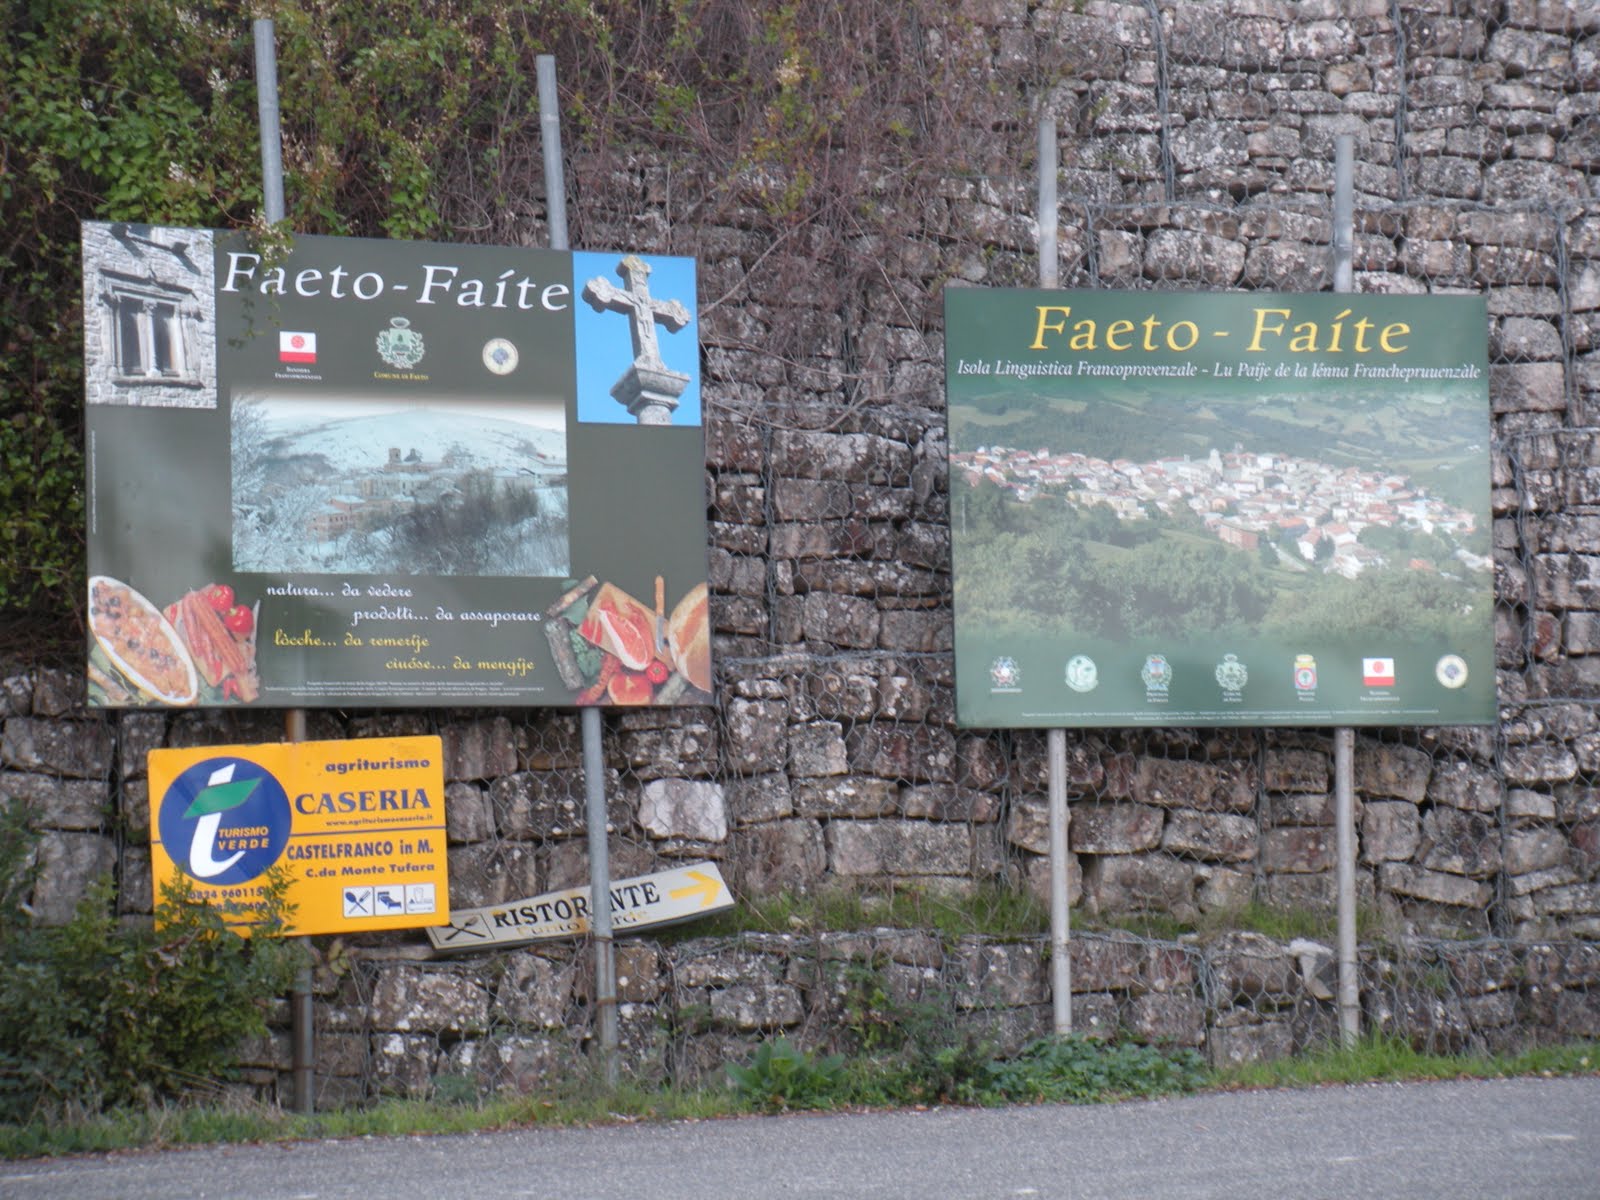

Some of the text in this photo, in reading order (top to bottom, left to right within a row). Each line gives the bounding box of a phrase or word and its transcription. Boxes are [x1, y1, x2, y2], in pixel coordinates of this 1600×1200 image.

[1028, 305, 1200, 352] Faeto
[1246, 307, 1411, 353] Faíte
[957, 359, 990, 375] Isola
[995, 359, 1073, 380] Linguistica
[1078, 361, 1197, 381] Francoprovenzale
[1213, 363, 1232, 377] Lu
[1275, 362, 1290, 377] de
[1294, 363, 1309, 377] la
[266, 582, 413, 598] natura... da vedere
[351, 606, 541, 627] prodotti... da assaporare
[344, 631, 363, 647] da
[453, 654, 470, 670] da
[325, 757, 430, 776] agriturismo
[295, 788, 432, 815] CASERIA
[218, 826, 269, 838] TURISMO
[218, 838, 269, 849] VERDE
[287, 839, 433, 860] CASTELFRANCO in M.
[305, 862, 435, 878] C.da Monte Tufara
[493, 881, 660, 928] RISTORNTE
